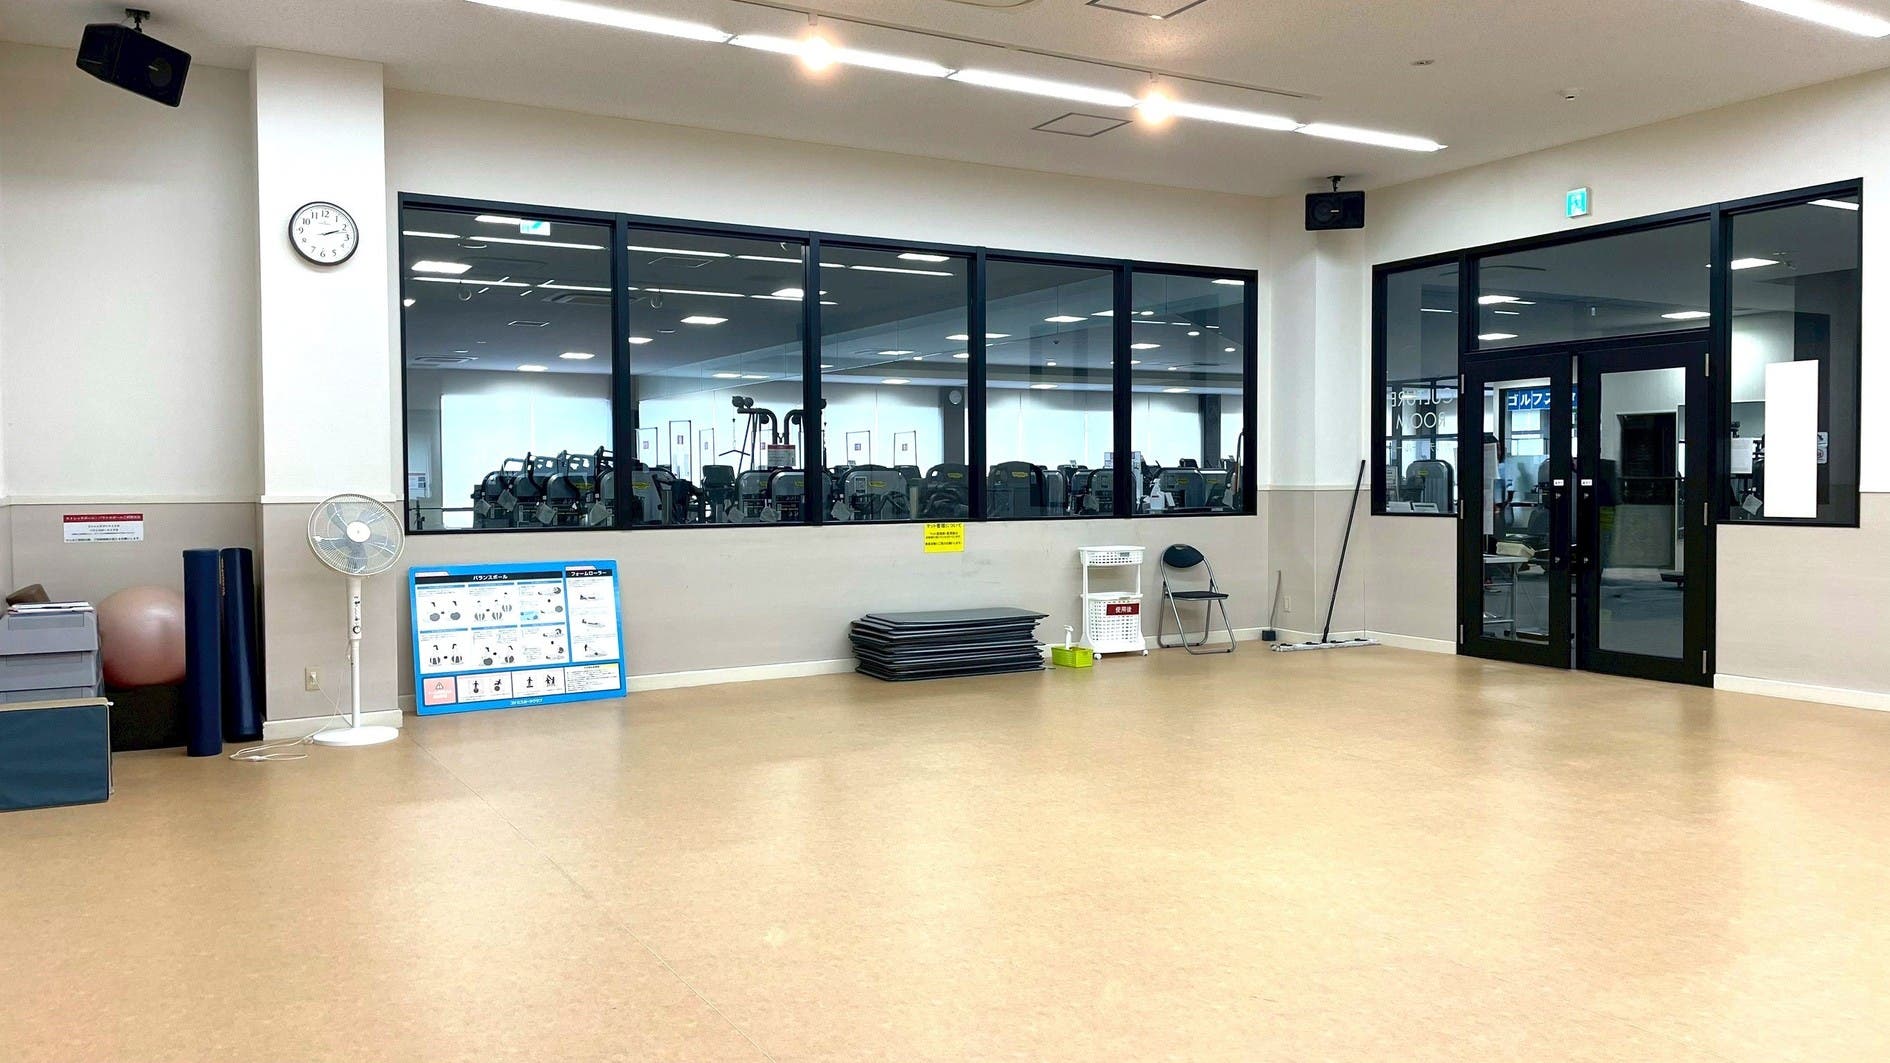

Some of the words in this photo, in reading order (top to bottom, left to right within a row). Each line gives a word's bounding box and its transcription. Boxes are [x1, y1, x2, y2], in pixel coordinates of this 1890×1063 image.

[311, 211, 318, 220] 11
[321, 210, 330, 218] 12
[302, 217, 311, 225] 10
[341, 223, 347, 231] 2
[344, 233, 350, 241] 3
[319, 249, 326, 257] 6
[331, 249, 337, 257] 5
